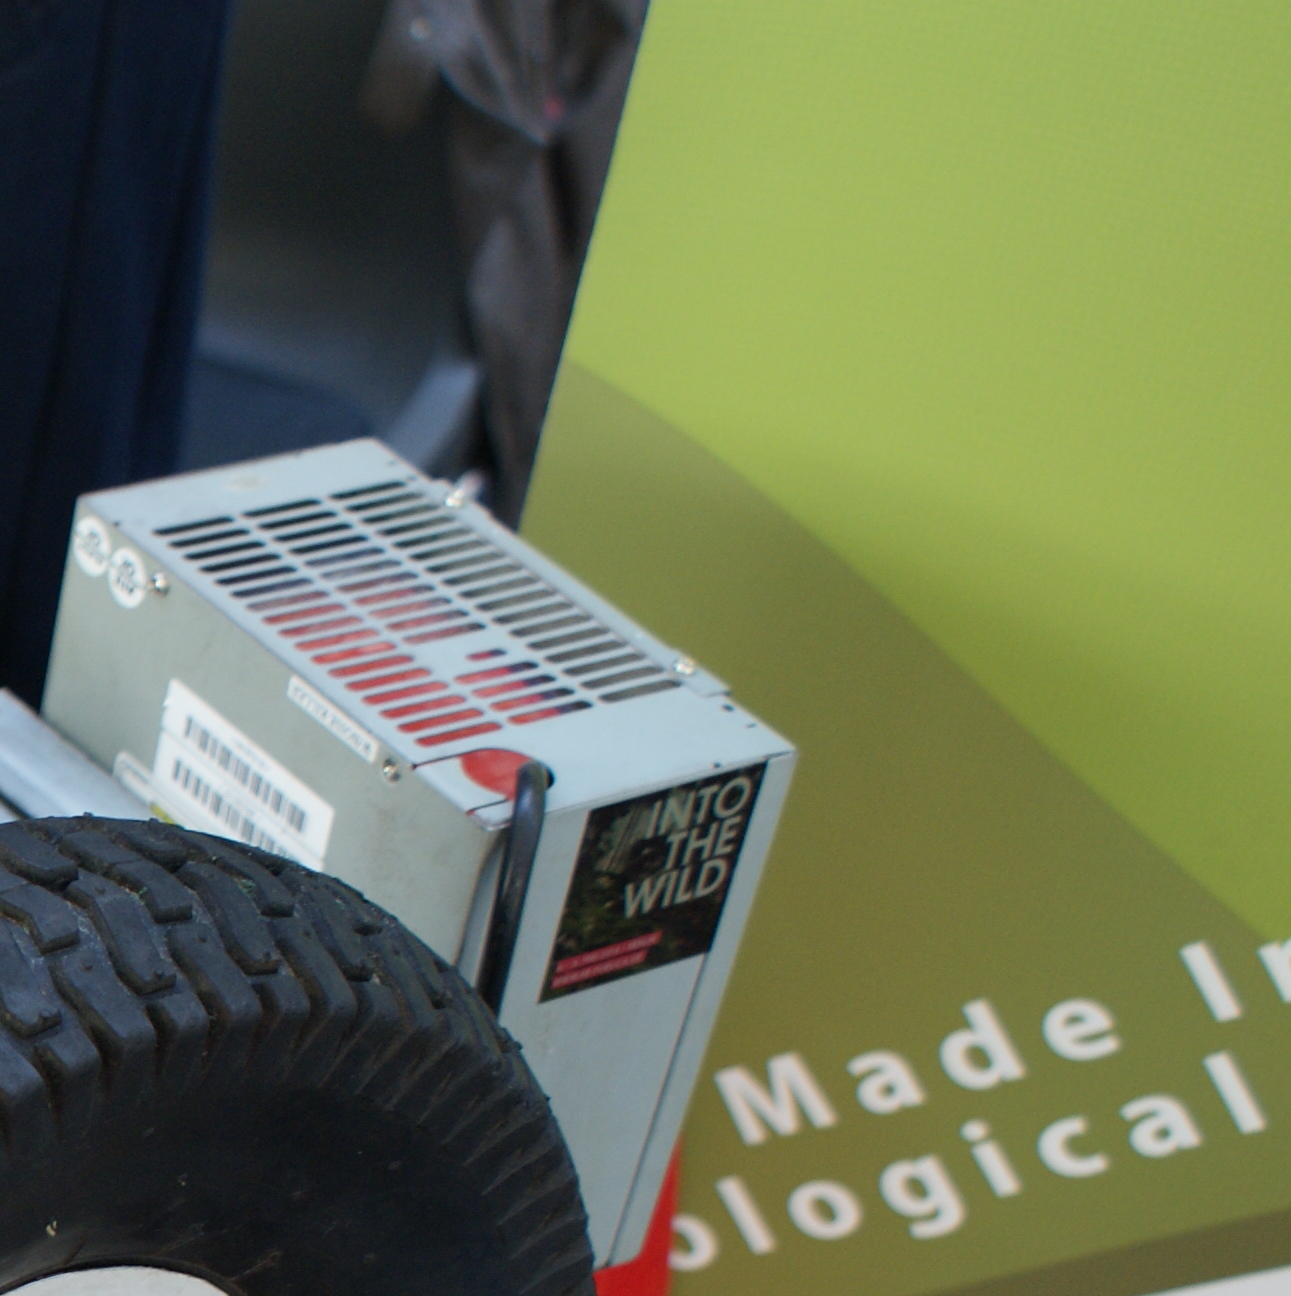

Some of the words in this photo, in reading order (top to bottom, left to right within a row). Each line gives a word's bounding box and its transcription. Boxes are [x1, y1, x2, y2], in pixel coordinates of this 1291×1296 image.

[645, 776, 751, 840] INTO
[662, 816, 741, 872] THE
[623, 857, 727, 919] WILD
[715, 998, 1121, 1146] Made
